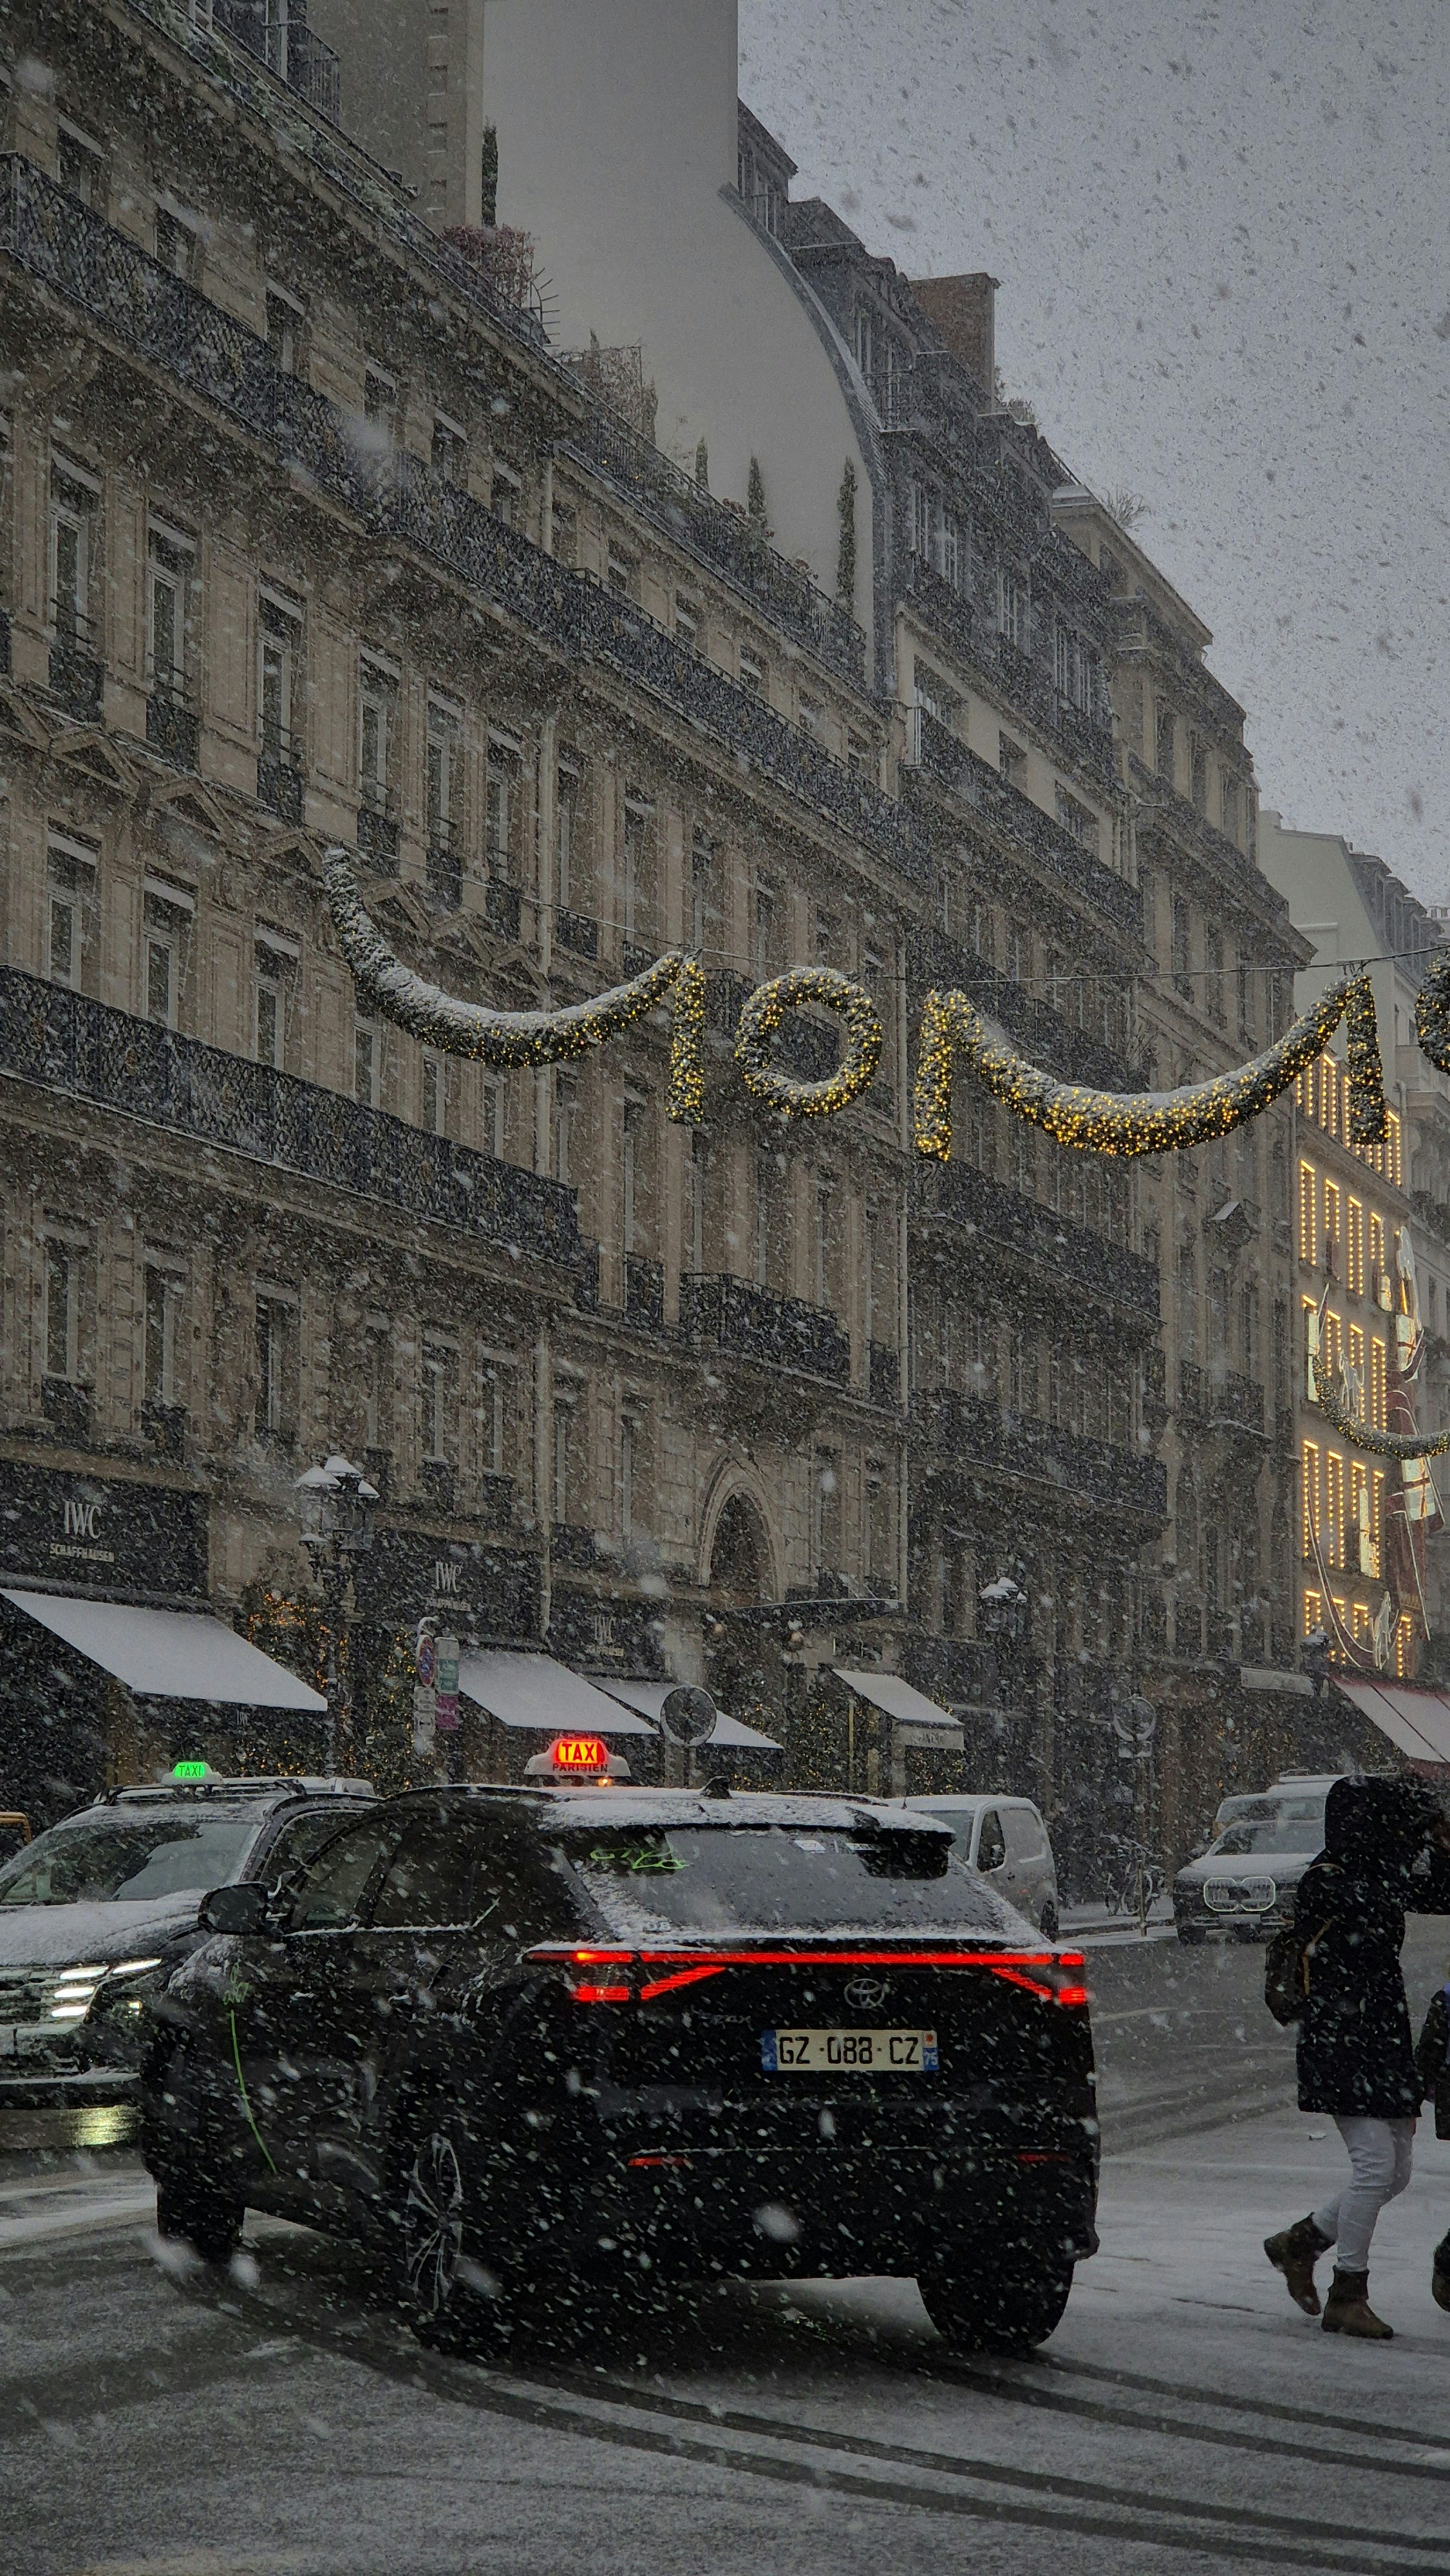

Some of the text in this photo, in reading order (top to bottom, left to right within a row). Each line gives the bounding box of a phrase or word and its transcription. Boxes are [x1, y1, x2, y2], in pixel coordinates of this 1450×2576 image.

[64, 1501, 102, 1539] IWC
[179, 1765, 201, 1776] TAXI
[552, 1763, 608, 1772] PARISIEN
